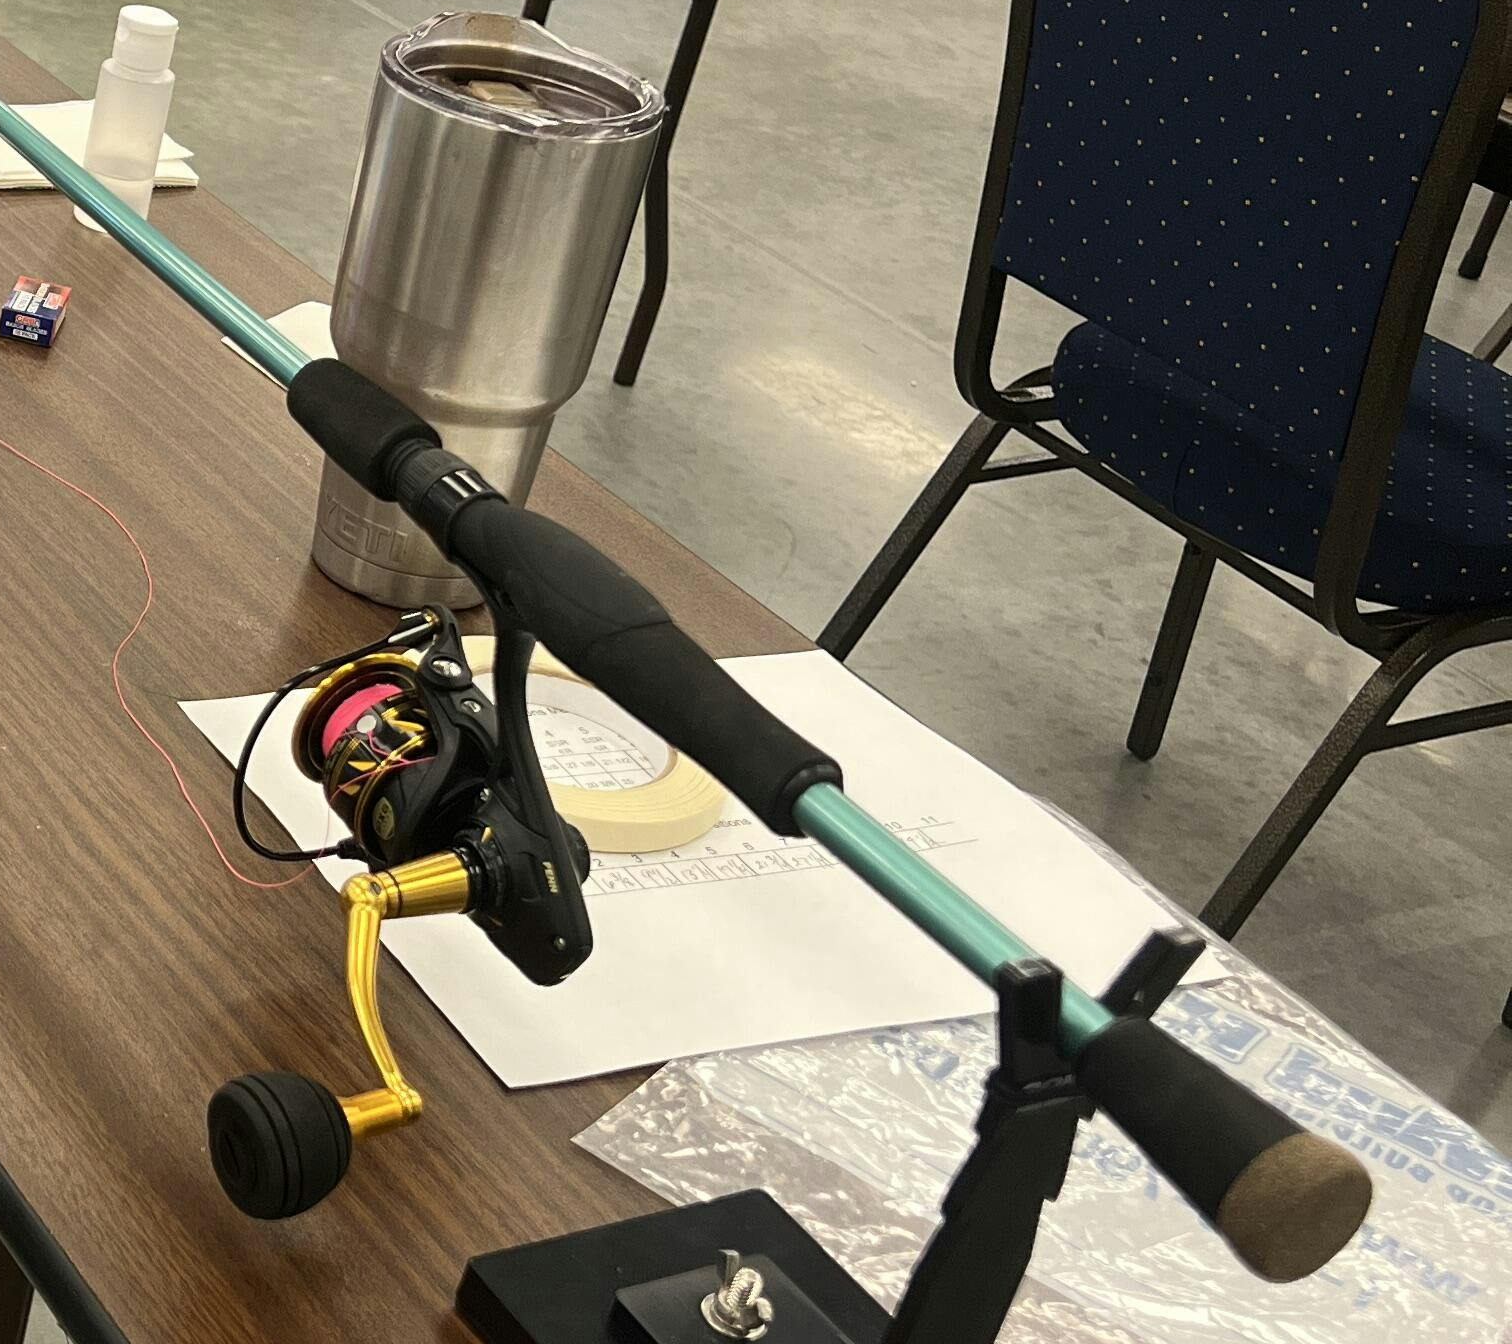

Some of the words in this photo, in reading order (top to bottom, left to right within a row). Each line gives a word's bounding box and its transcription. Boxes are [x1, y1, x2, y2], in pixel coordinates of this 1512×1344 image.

[326, 497, 408, 562] YETI
[592, 858, 603, 867] 2
[631, 854, 643, 863] 3
[705, 846, 717, 855] 5
